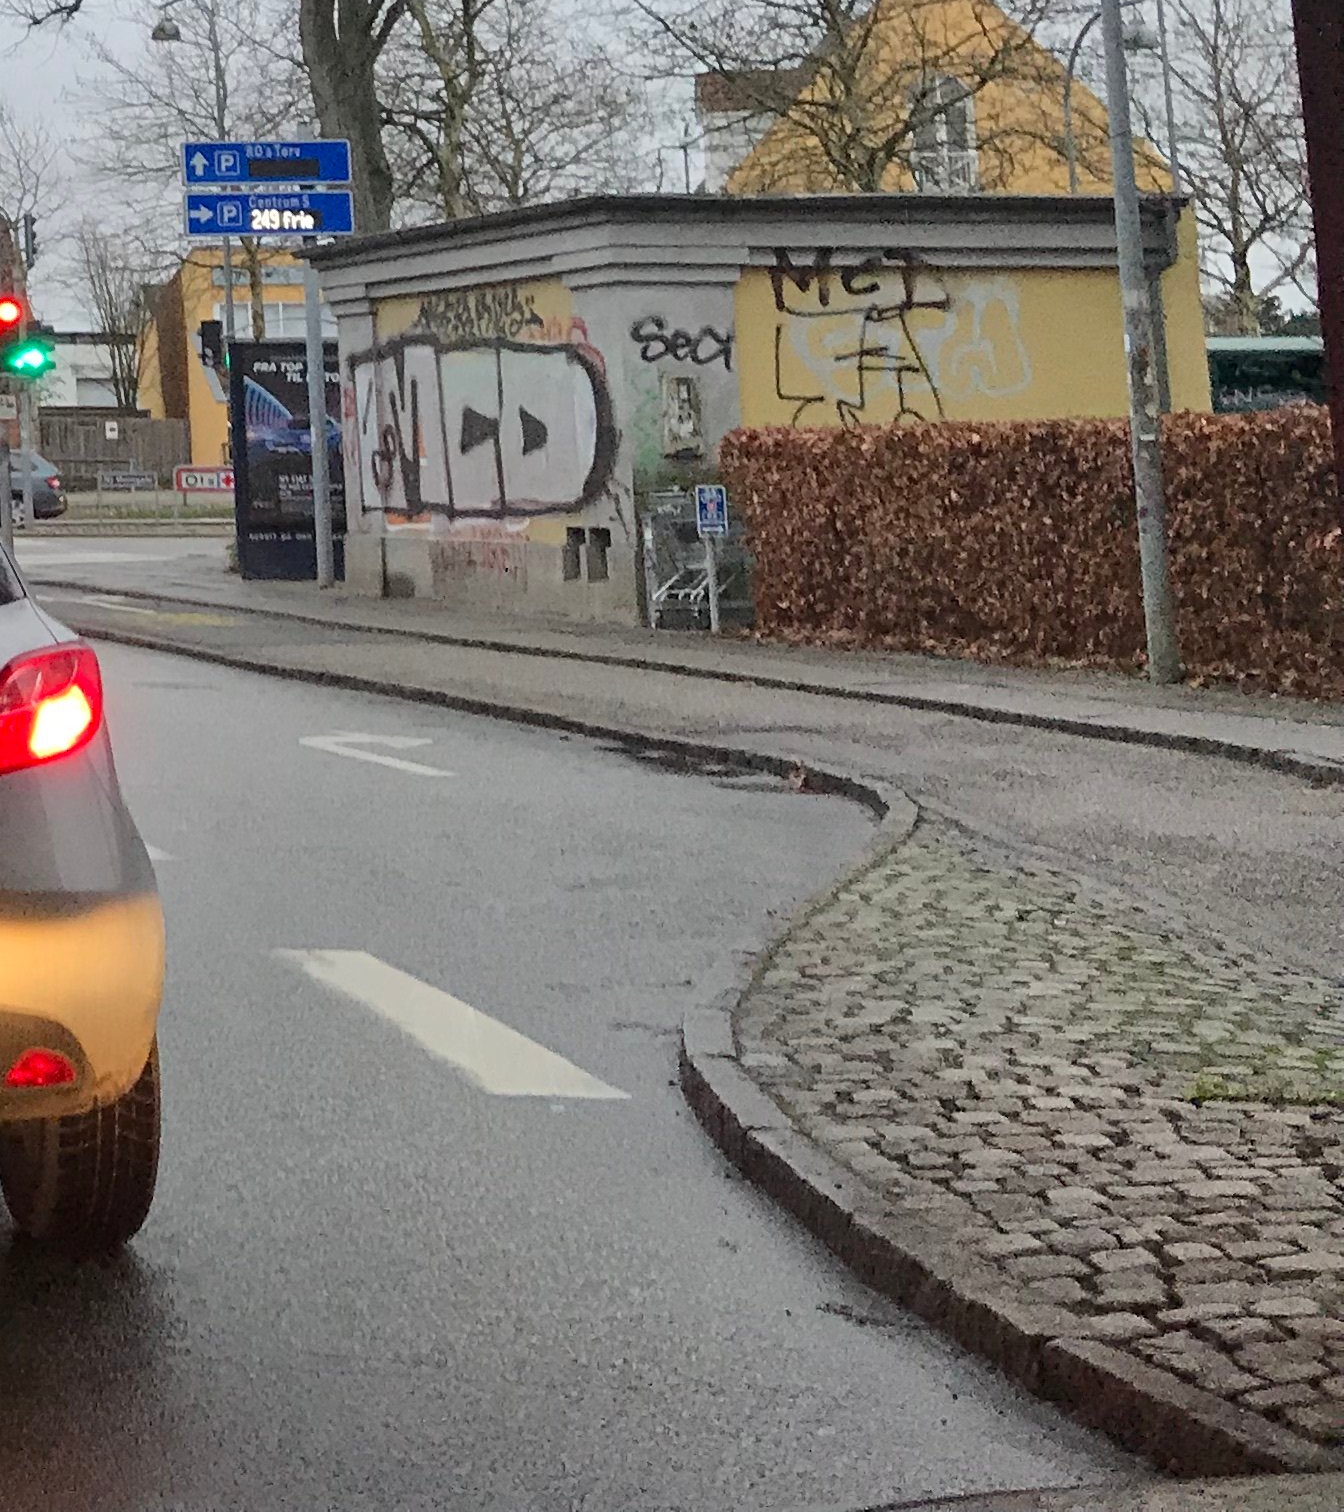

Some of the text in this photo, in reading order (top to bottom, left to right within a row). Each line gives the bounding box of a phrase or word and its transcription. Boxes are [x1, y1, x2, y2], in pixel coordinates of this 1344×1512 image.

[248, 194, 298, 208] Centrum
[251, 209, 280, 230] 249
[280, 361, 303, 373] TOP
[286, 372, 303, 383] TIL
